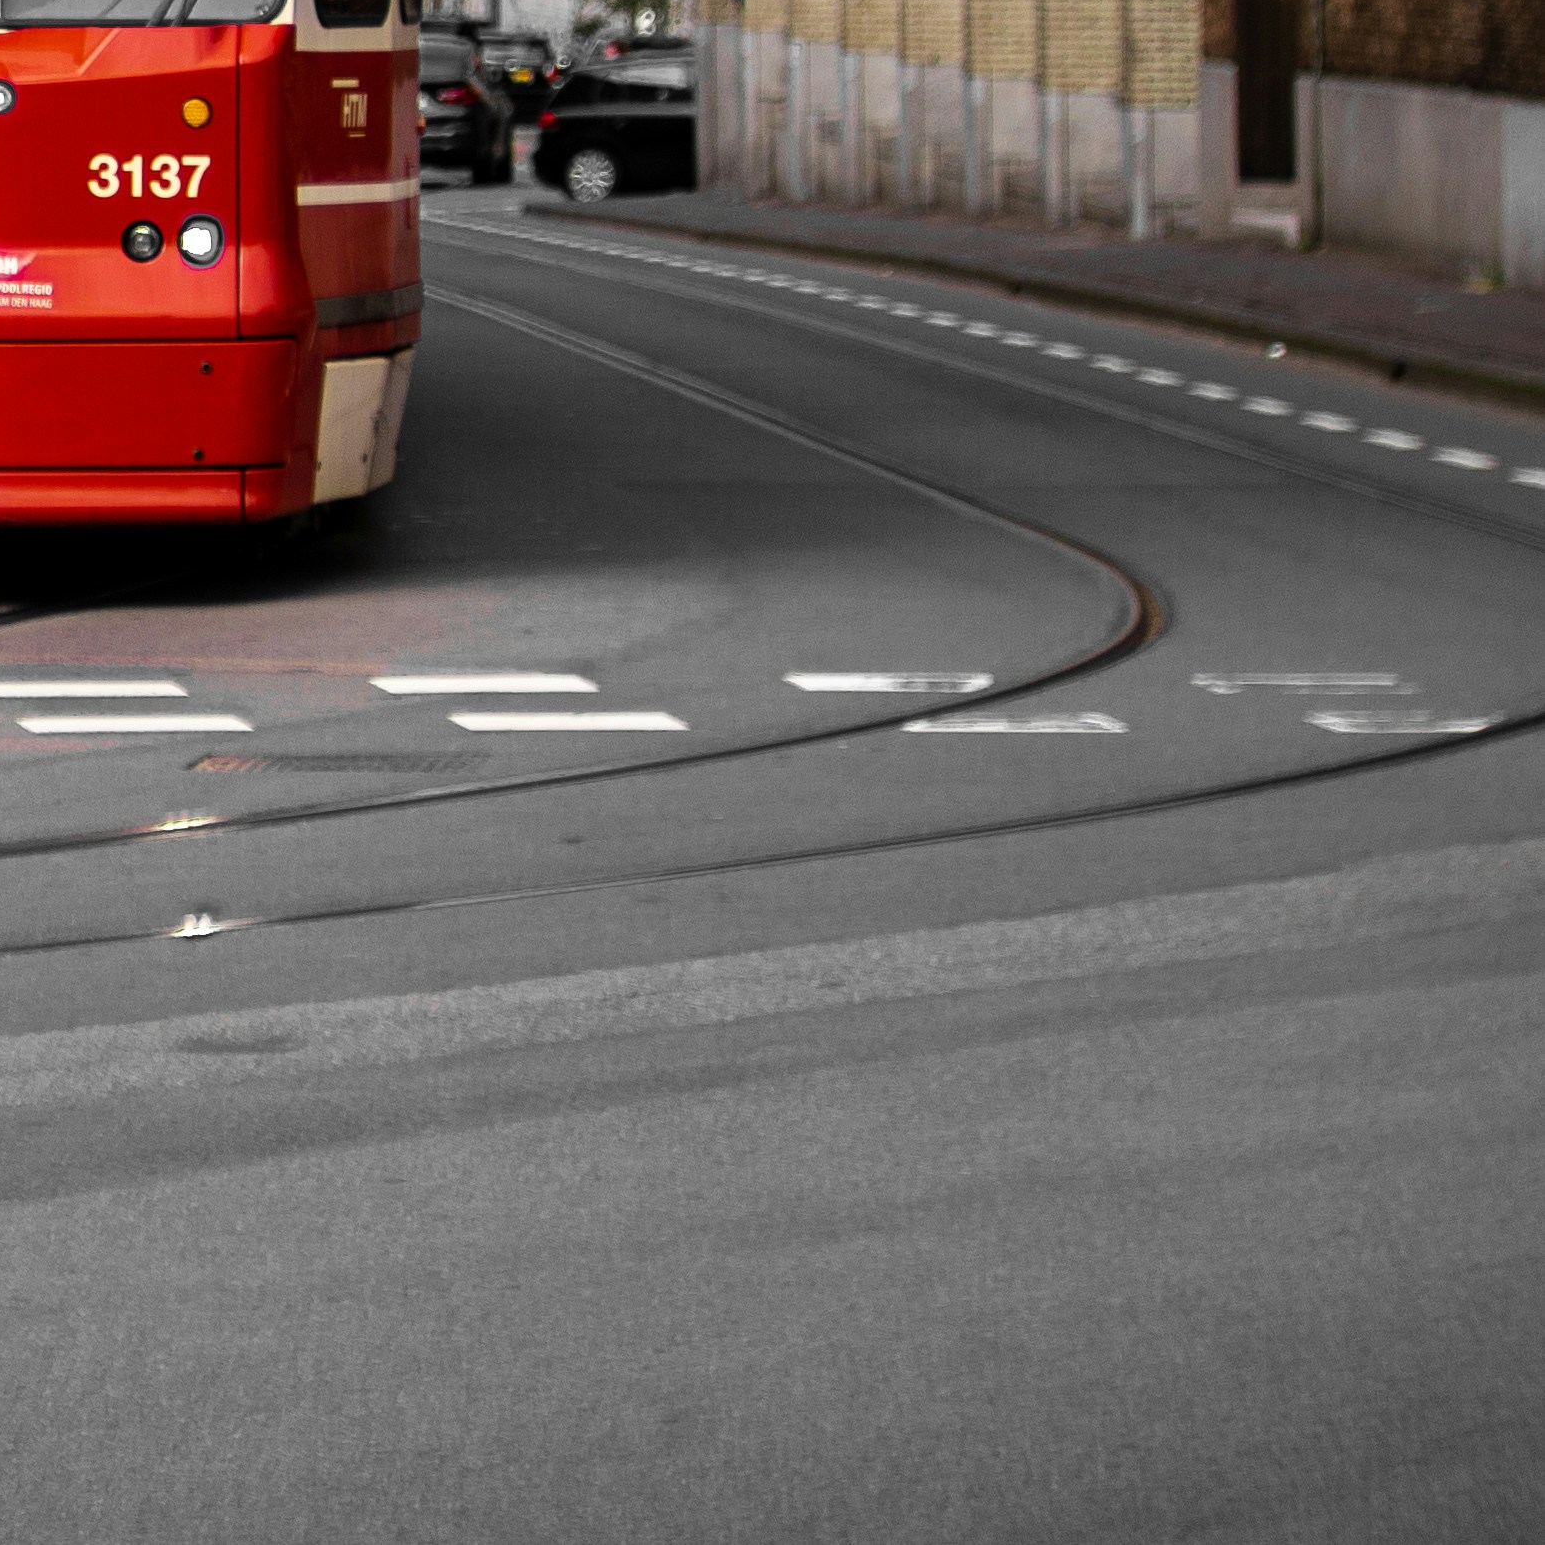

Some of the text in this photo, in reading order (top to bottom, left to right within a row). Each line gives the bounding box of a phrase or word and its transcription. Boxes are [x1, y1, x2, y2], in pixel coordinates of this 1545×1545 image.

[341, 94, 368, 128] HTM
[86, 152, 212, 199] 3137
[11, 297, 28, 308] DEN
[29, 298, 53, 309] HAAG
